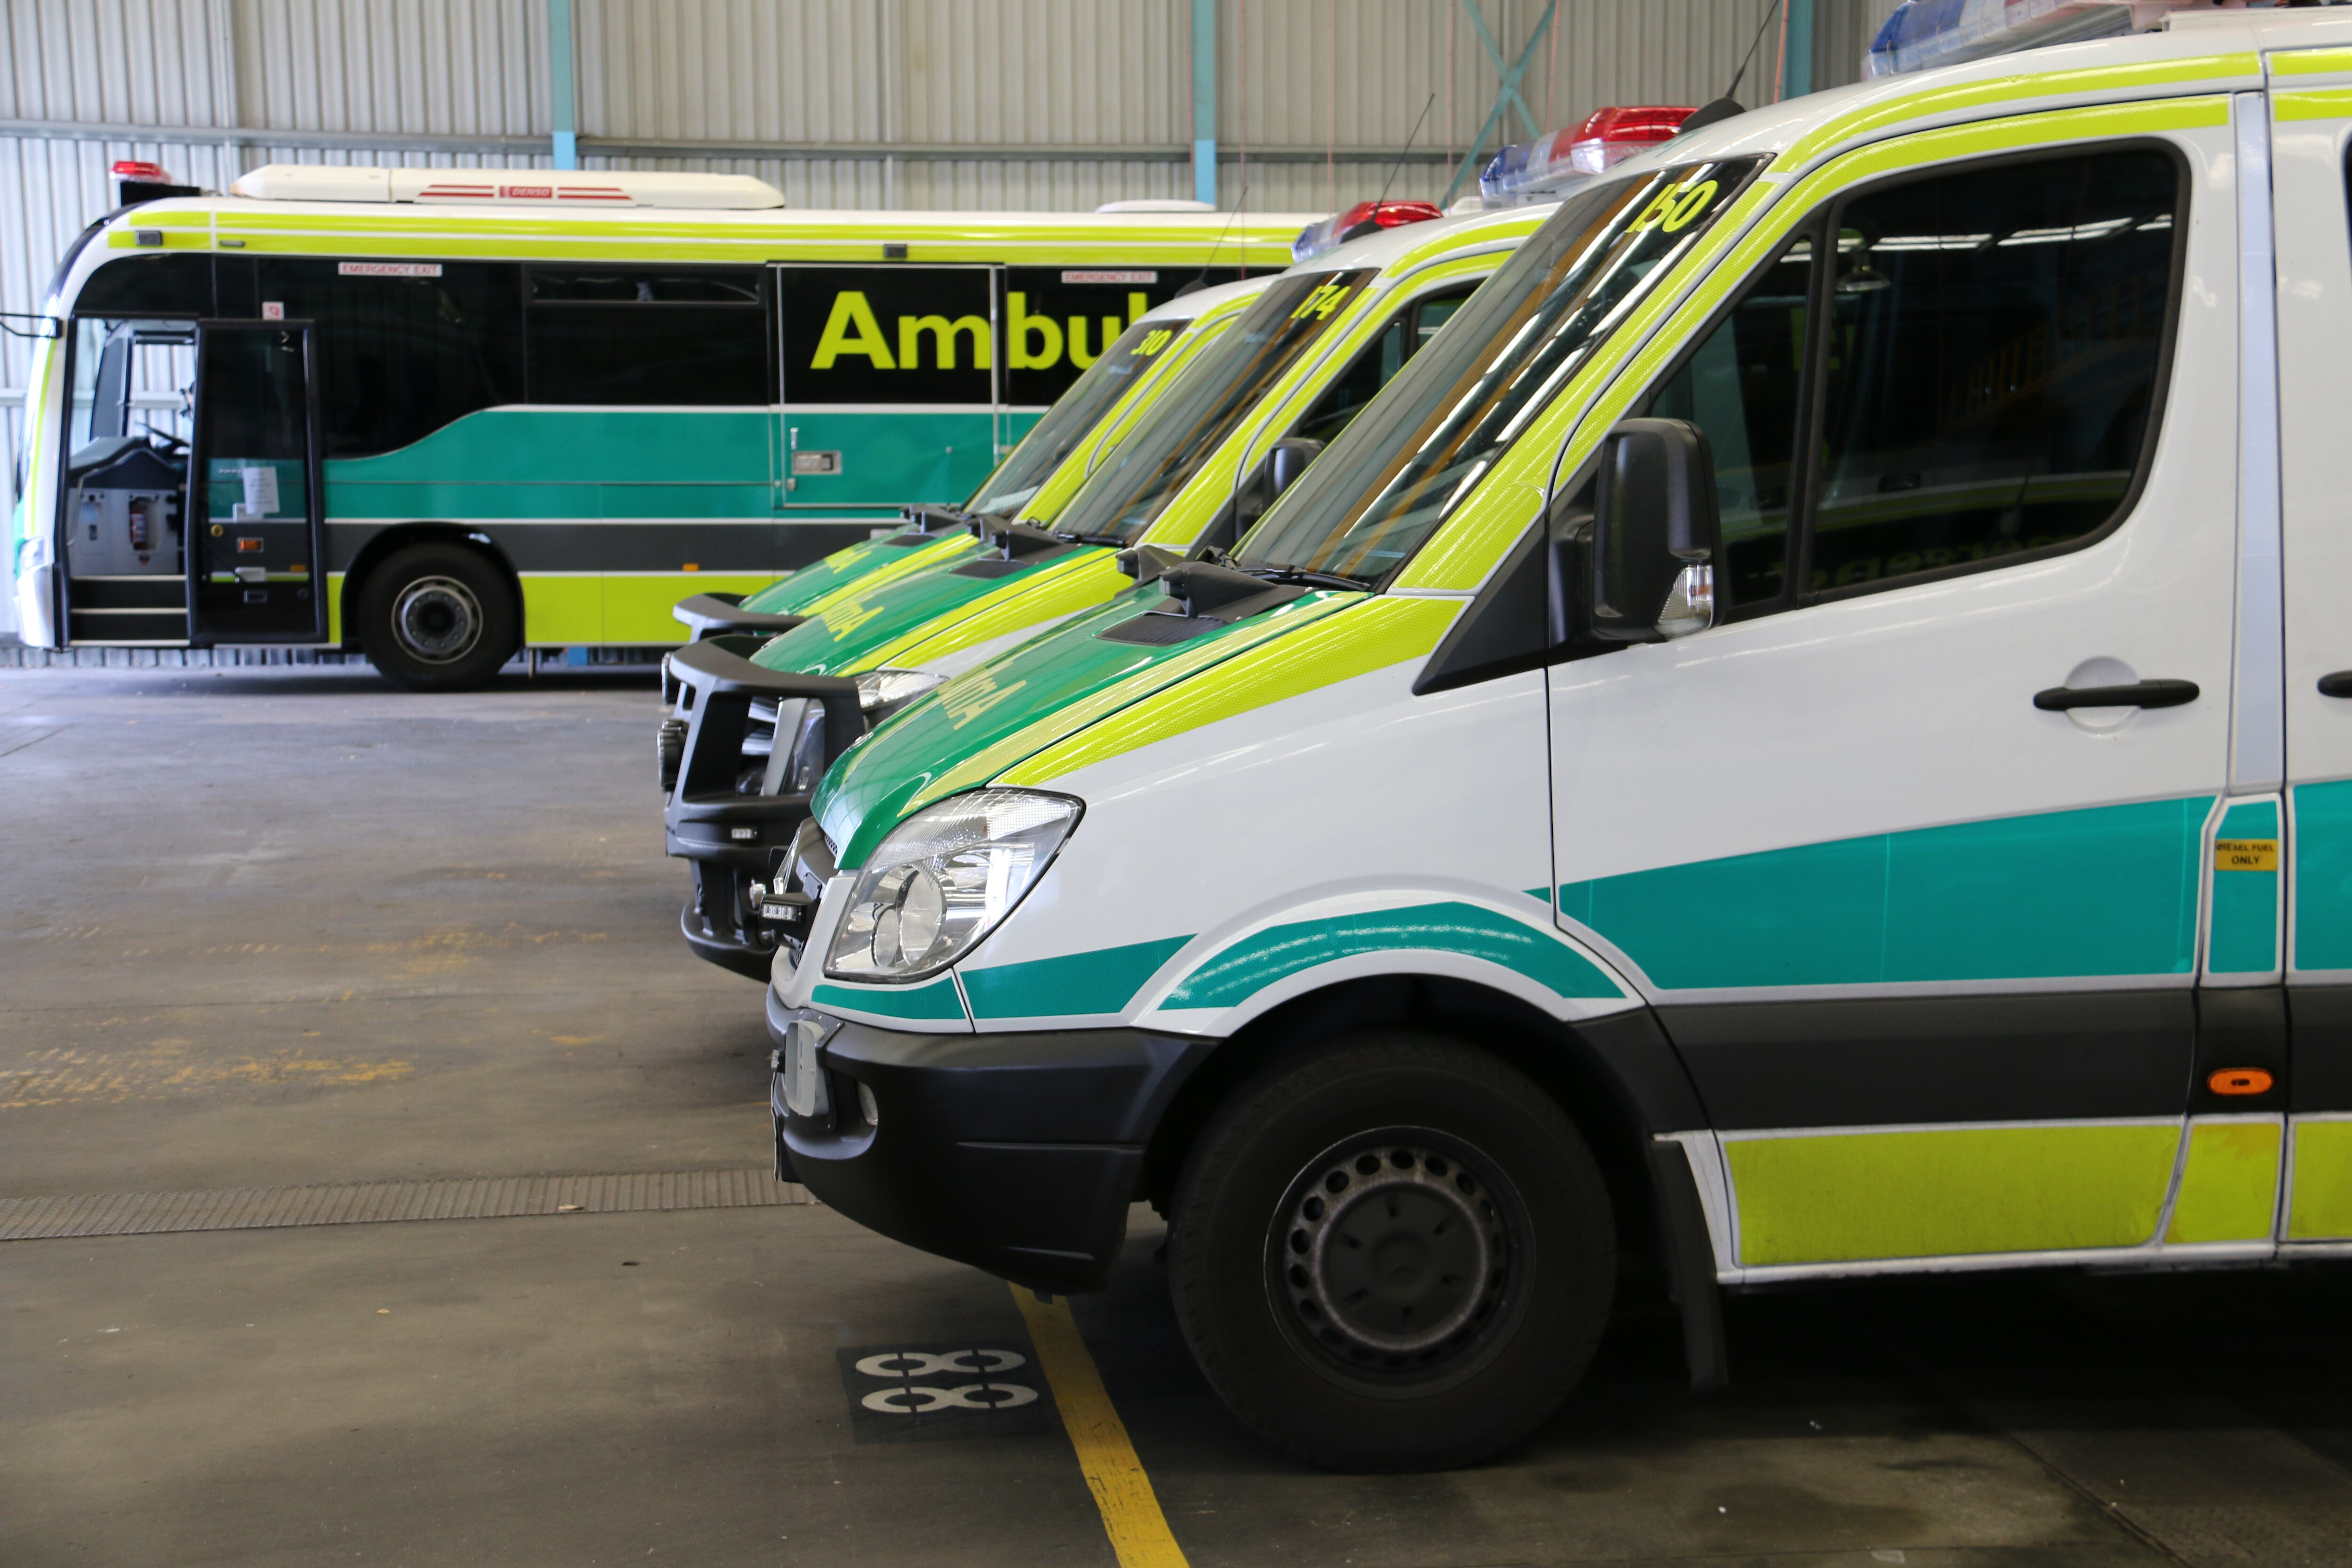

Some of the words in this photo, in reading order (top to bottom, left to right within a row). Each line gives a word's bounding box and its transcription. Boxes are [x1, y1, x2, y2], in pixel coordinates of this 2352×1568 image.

[511, 188, 551, 197] DENSO
[1625, 180, 1719, 233] 150
[344, 263, 410, 275] EMERGENCY
[414, 264, 437, 276] EXIT
[2217, 843, 2249, 851] DIESEL
[2231, 855, 2260, 865] ONLY
[855, 1349, 1038, 1413] 88
